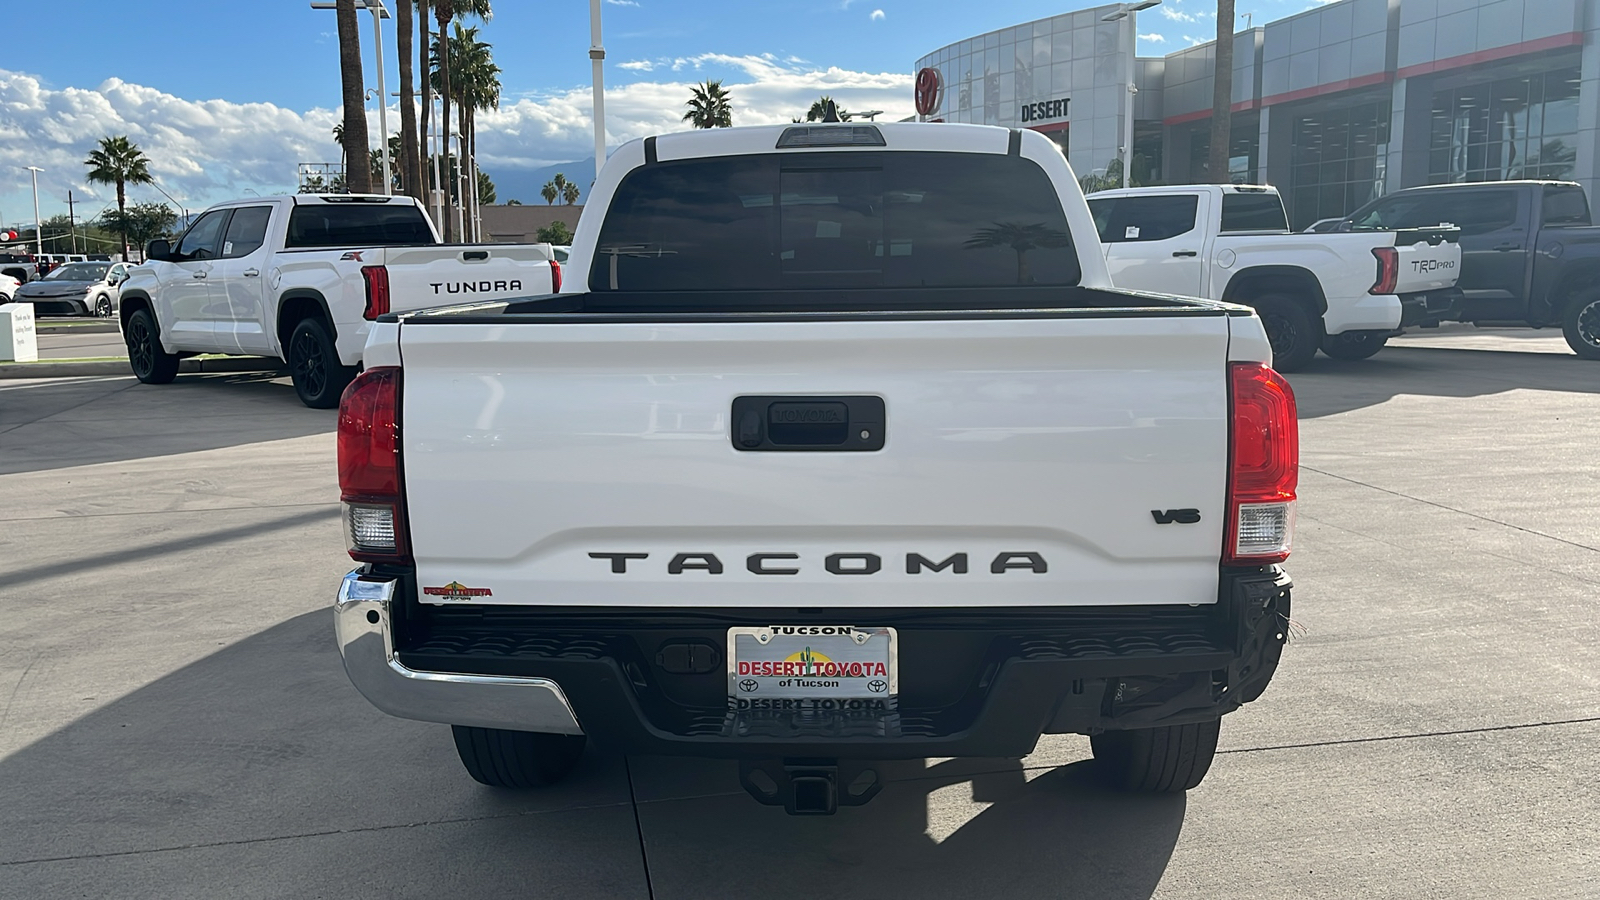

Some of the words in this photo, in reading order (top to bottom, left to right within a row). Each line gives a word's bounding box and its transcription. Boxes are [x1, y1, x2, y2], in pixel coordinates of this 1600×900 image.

[1021, 98, 1071, 123] DESERT
[430, 280, 522, 294] TUNDRA
[775, 409, 843, 422] TOYOTA
[1150, 508, 1201, 524] V6
[588, 552, 1048, 575] TACOMA
[770, 627, 852, 635] TUCSON
[738, 661, 806, 676] DESERT
[812, 662, 887, 676] TOYOTA
[778, 679, 792, 688] of
[793, 678, 840, 688] Tucson
[737, 698, 802, 710] DESERT
[810, 699, 886, 711] TOYOTA
